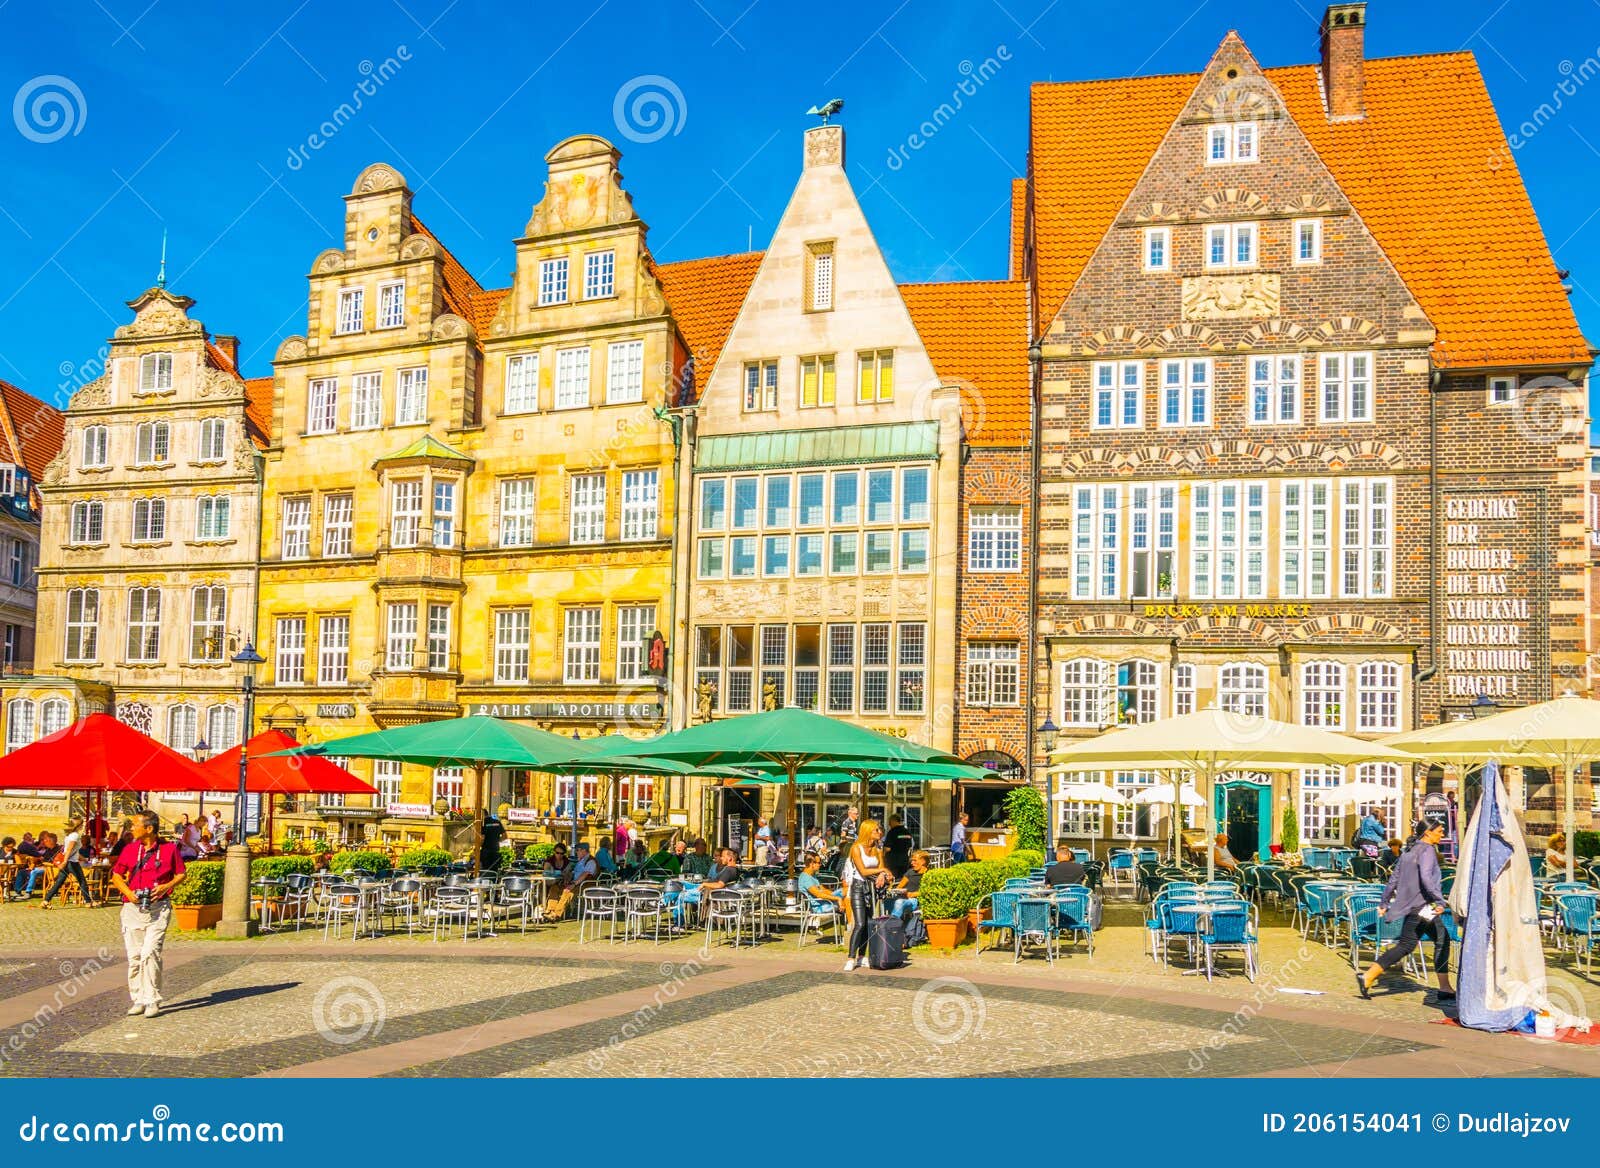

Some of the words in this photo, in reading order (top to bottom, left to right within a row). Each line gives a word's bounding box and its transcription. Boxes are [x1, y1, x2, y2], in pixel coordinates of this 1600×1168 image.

[1447, 524, 1478, 544] DER
[1447, 574, 1472, 594] DIE
[1477, 574, 1507, 594] DAS
[1210, 604, 1238, 618] AM
[1245, 604, 1312, 618] MARKT
[1447, 599, 1530, 619] SCHICKSAL
[1447, 624, 1519, 645] UNSERER
[1447, 649, 1531, 672] TRENNUNG
[557, 704, 650, 717] APOTHEKE
[5, 802, 60, 812] SPARKASSE
